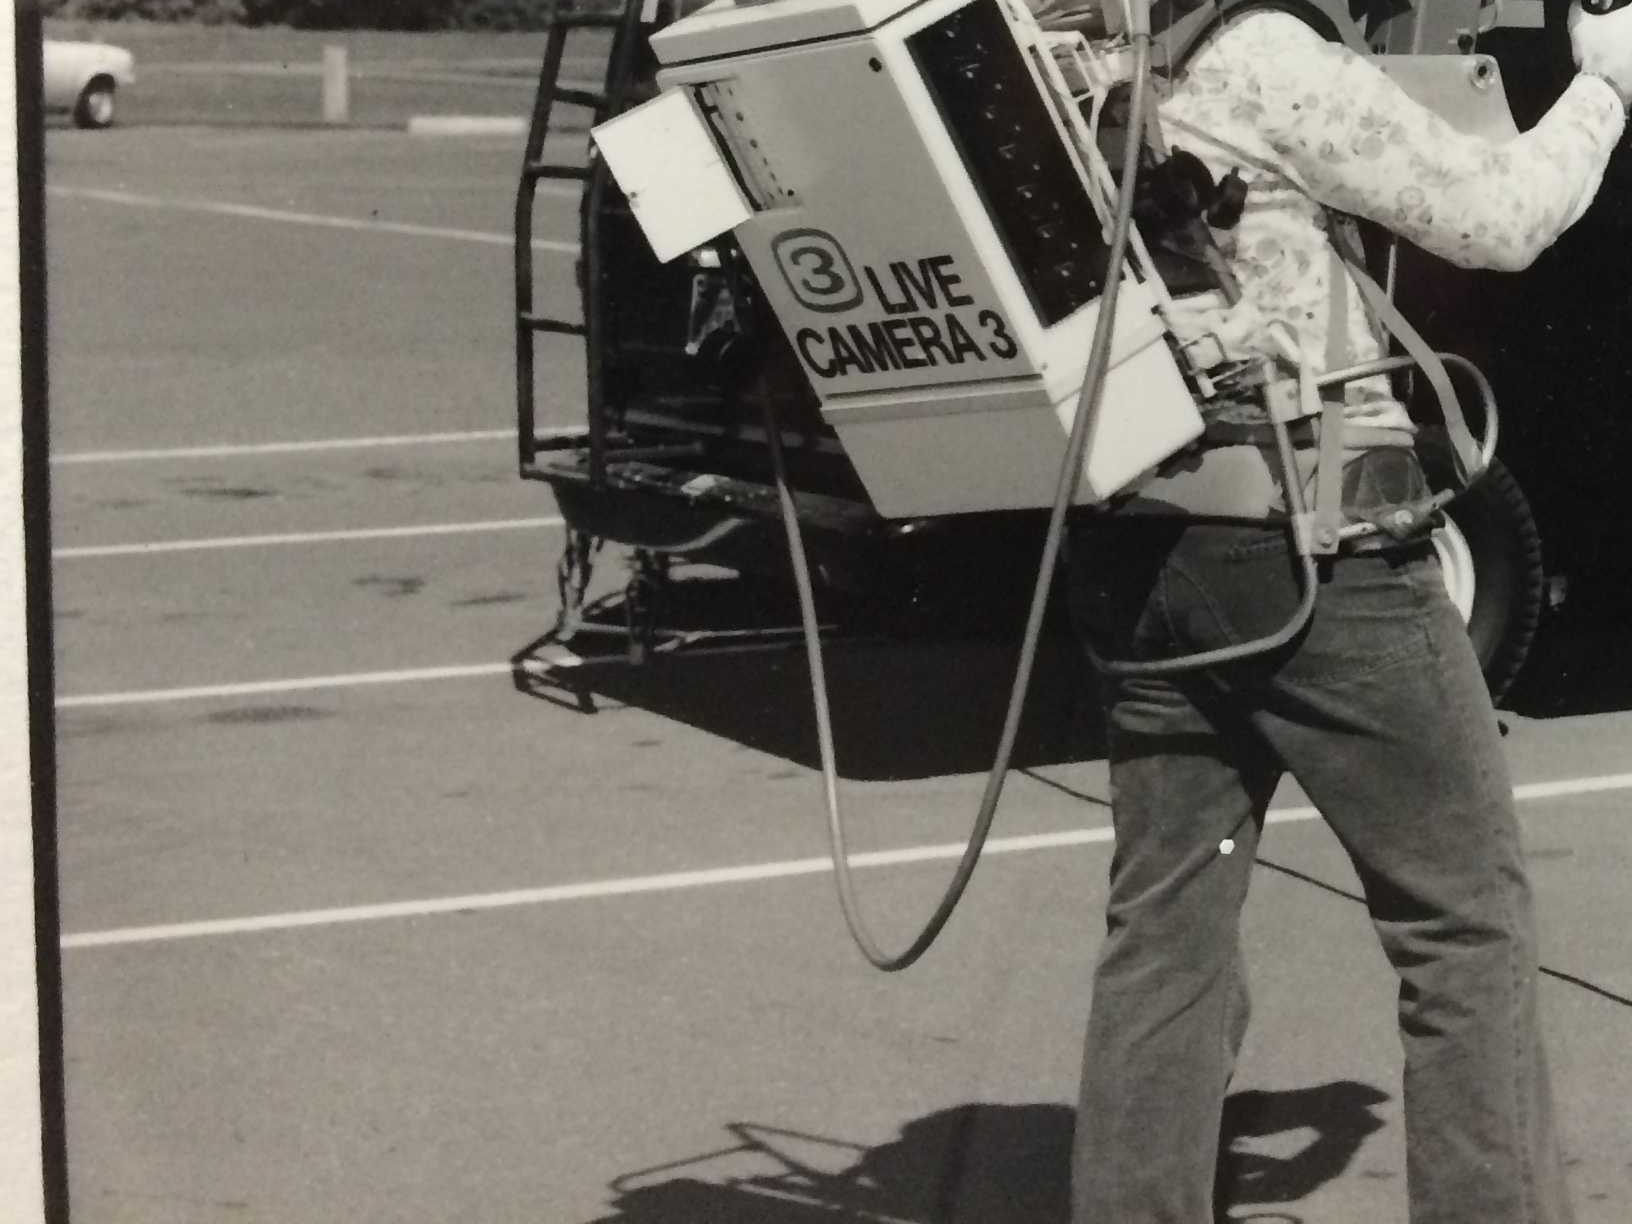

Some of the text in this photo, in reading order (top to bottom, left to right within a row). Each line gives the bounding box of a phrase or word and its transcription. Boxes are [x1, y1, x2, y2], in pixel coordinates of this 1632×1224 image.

[790, 246, 845, 295] 3
[864, 254, 975, 315] LIVE
[796, 309, 1018, 378] CAMERA 3
